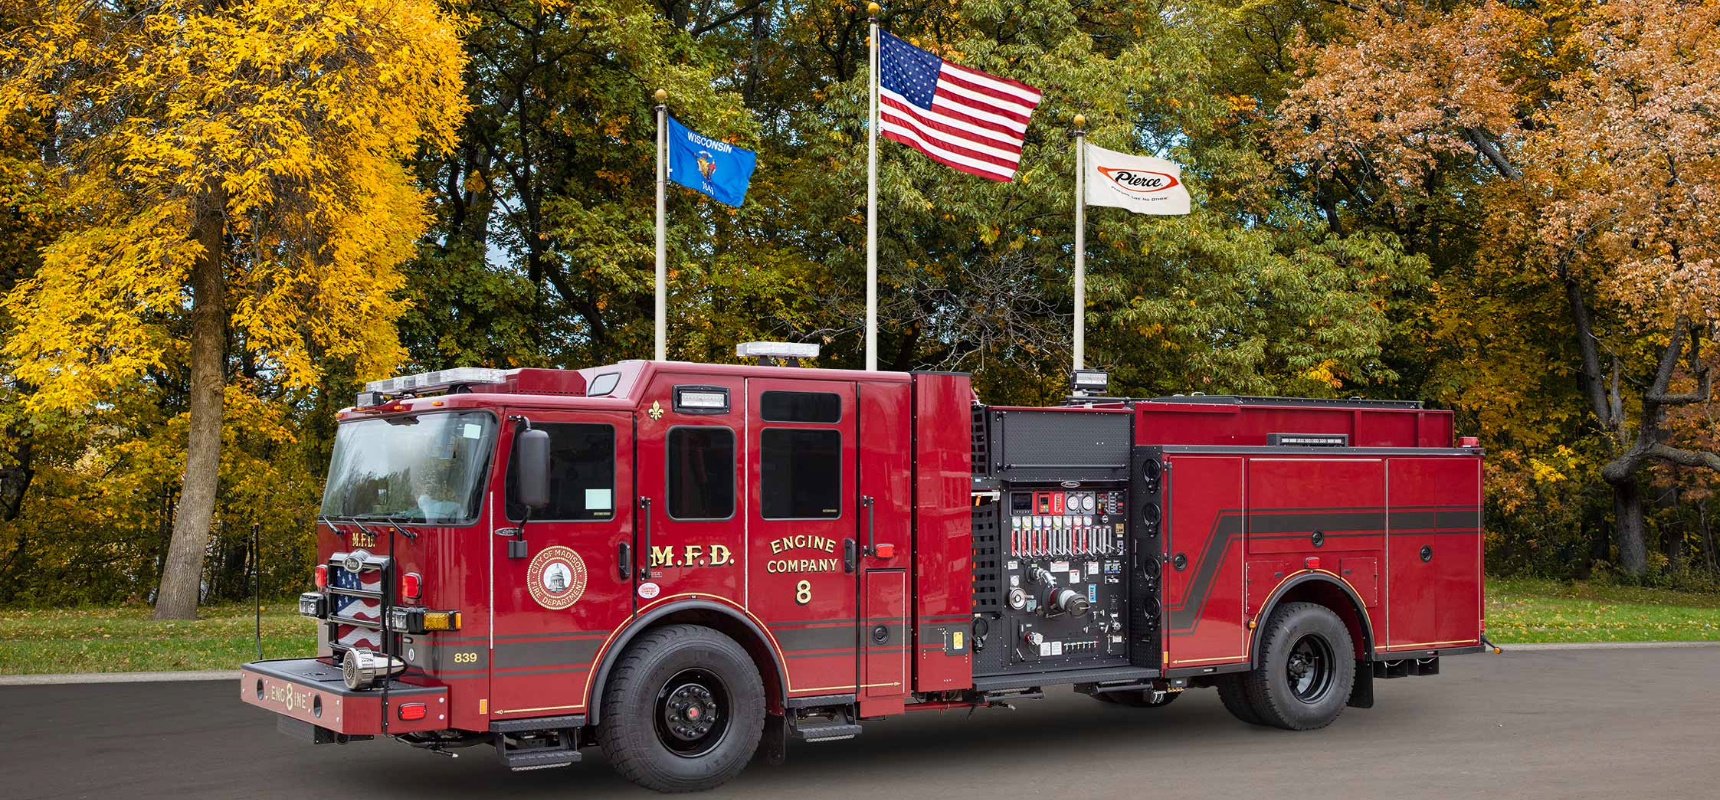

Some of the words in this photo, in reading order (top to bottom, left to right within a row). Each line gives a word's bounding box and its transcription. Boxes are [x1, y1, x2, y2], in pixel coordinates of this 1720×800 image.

[688, 132, 732, 153] WISCONSIN
[1115, 171, 1161, 187] Pierce
[770, 535, 836, 554] ENGINE
[531, 557, 543, 573] CITY
[543, 550, 553, 560] OF
[554, 549, 584, 573] MADISON
[651, 545, 735, 567] M.F.D.
[767, 559, 838, 573] COMPANY
[531, 581, 541, 598] FIRE
[541, 581, 584, 607] DEPARTMENT
[795, 579, 812, 604] 8
[454, 652, 478, 663] 839
